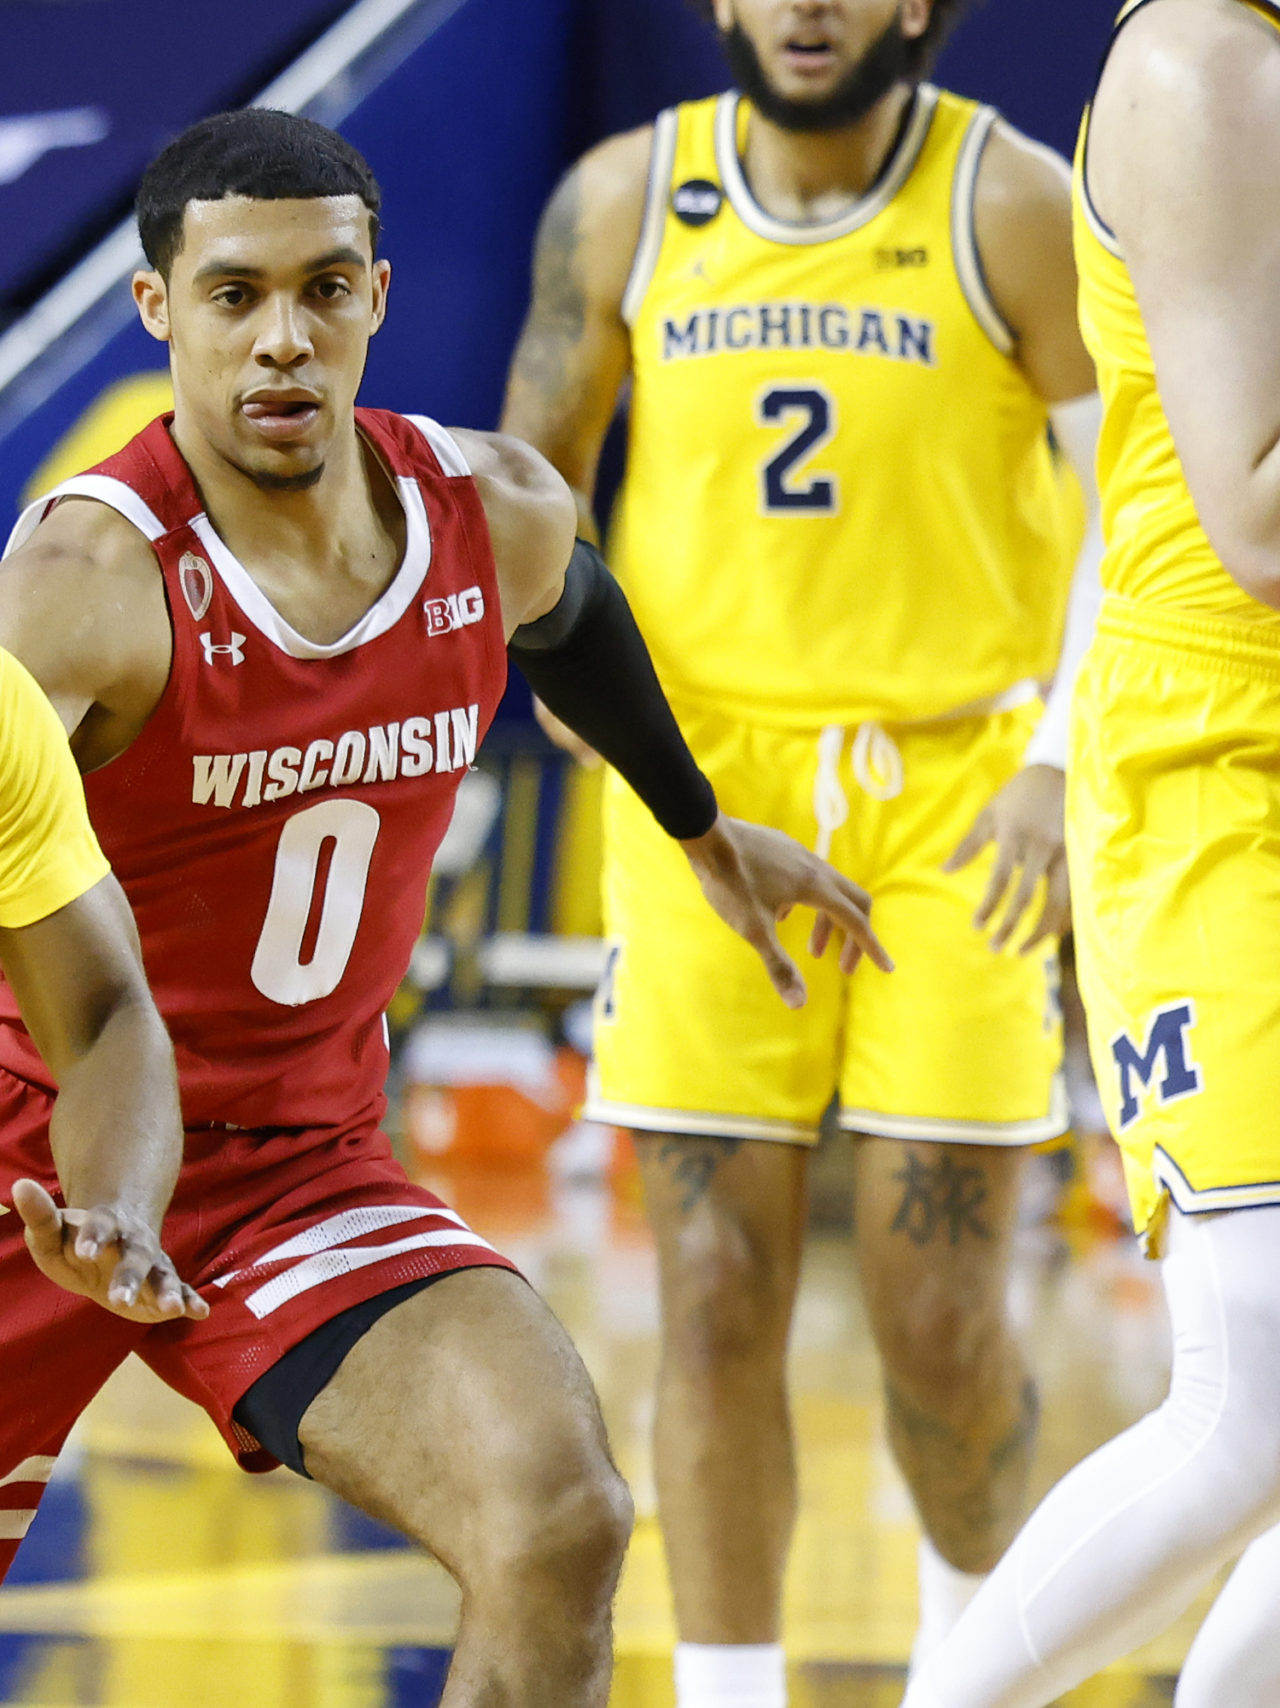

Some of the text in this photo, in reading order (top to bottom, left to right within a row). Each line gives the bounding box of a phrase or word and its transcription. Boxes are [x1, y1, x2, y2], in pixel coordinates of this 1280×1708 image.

[660, 302, 938, 367] MICHIGAN
[756, 384, 838, 516] 2
[191, 703, 480, 810] WISCONSIN
[1108, 996, 1202, 1131] M
